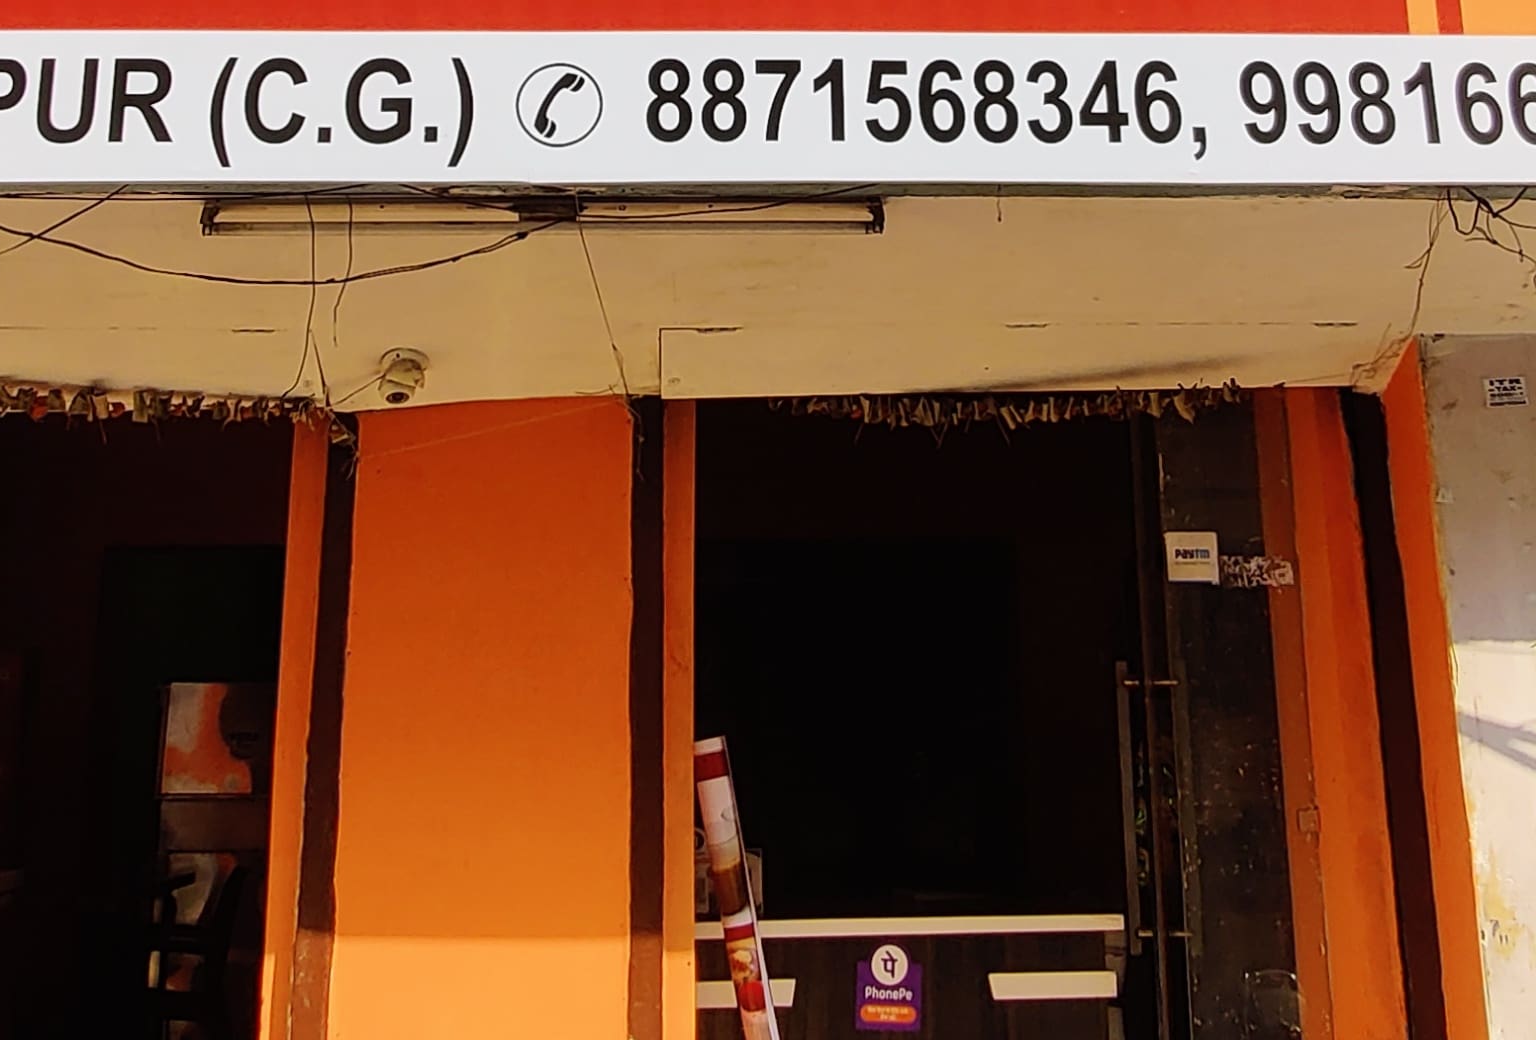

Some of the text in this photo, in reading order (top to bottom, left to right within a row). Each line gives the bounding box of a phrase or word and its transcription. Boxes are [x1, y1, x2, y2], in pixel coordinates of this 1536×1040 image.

[209, 57, 474, 168] (C.G.)
[646, 58, 1208, 161] 8871568346,
[864, 985, 914, 1002] PhonePe
